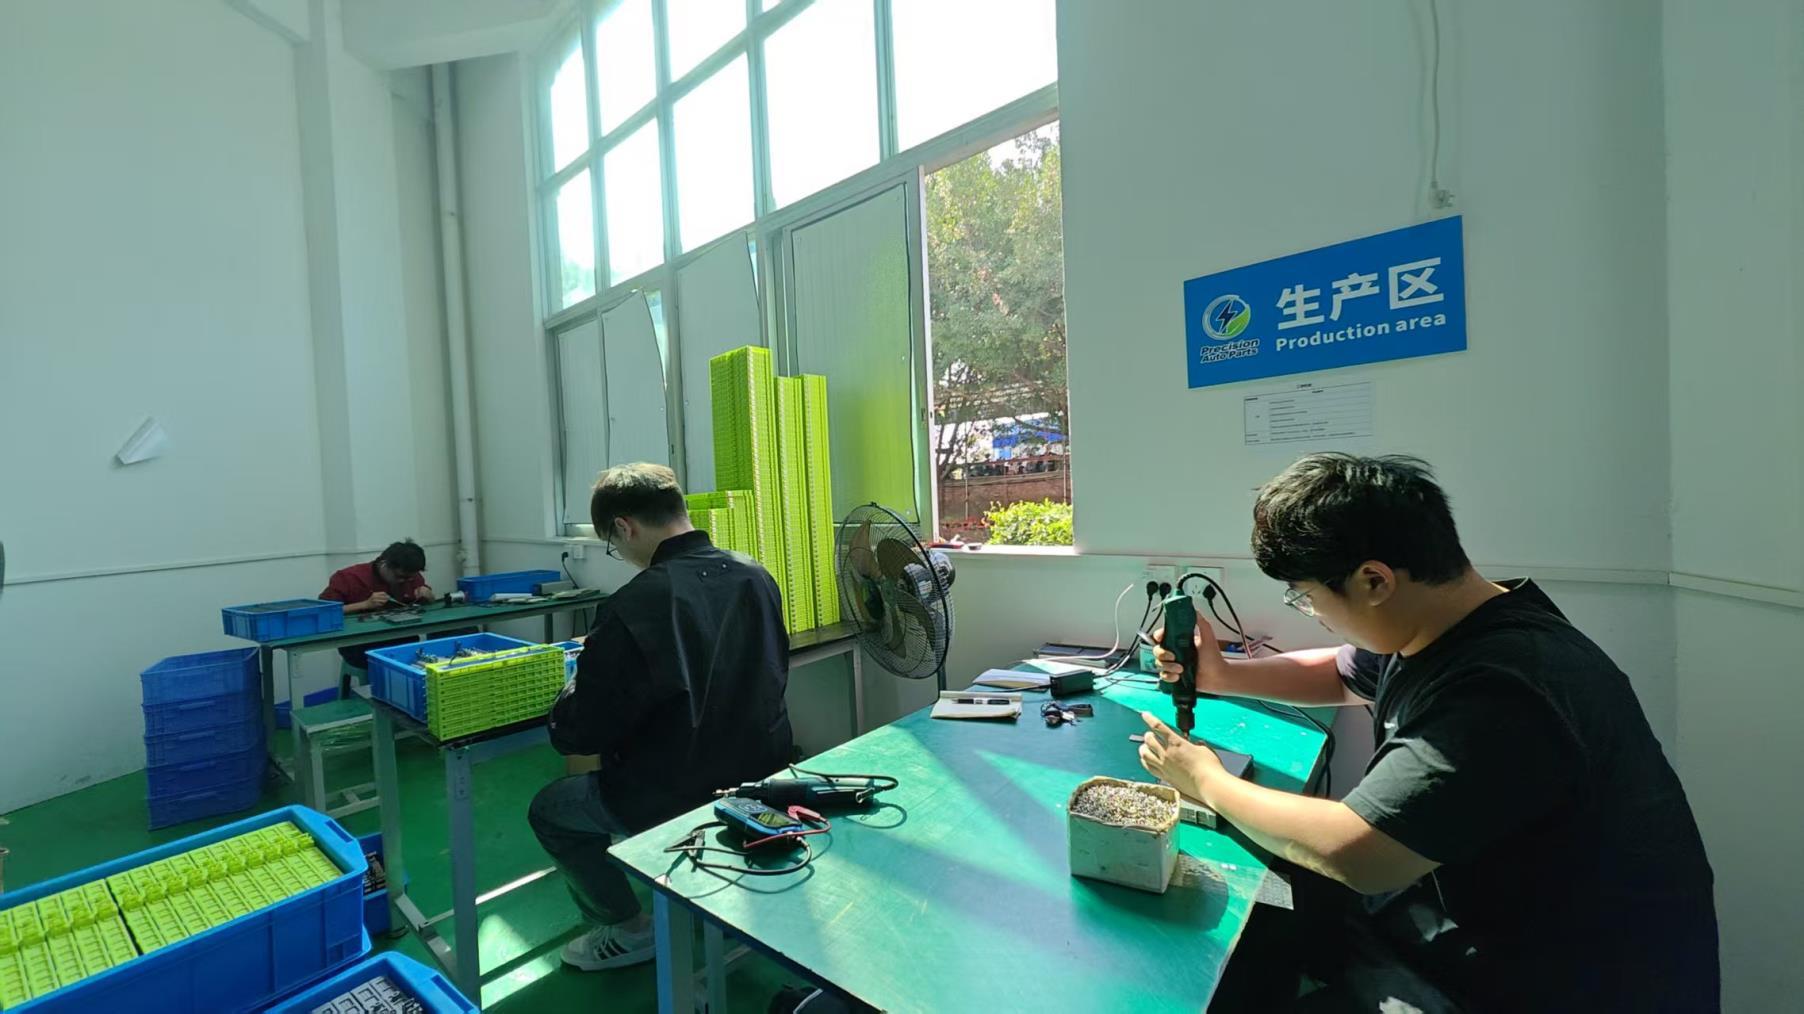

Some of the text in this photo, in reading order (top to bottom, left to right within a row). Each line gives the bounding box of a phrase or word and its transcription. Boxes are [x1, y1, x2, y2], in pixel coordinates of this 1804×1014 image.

[1276, 257, 1444, 330] 生产区
[1276, 313, 1446, 351] Production area
[1200, 339, 1259, 356] Precision
[1201, 348, 1258, 363] Auto Parts
